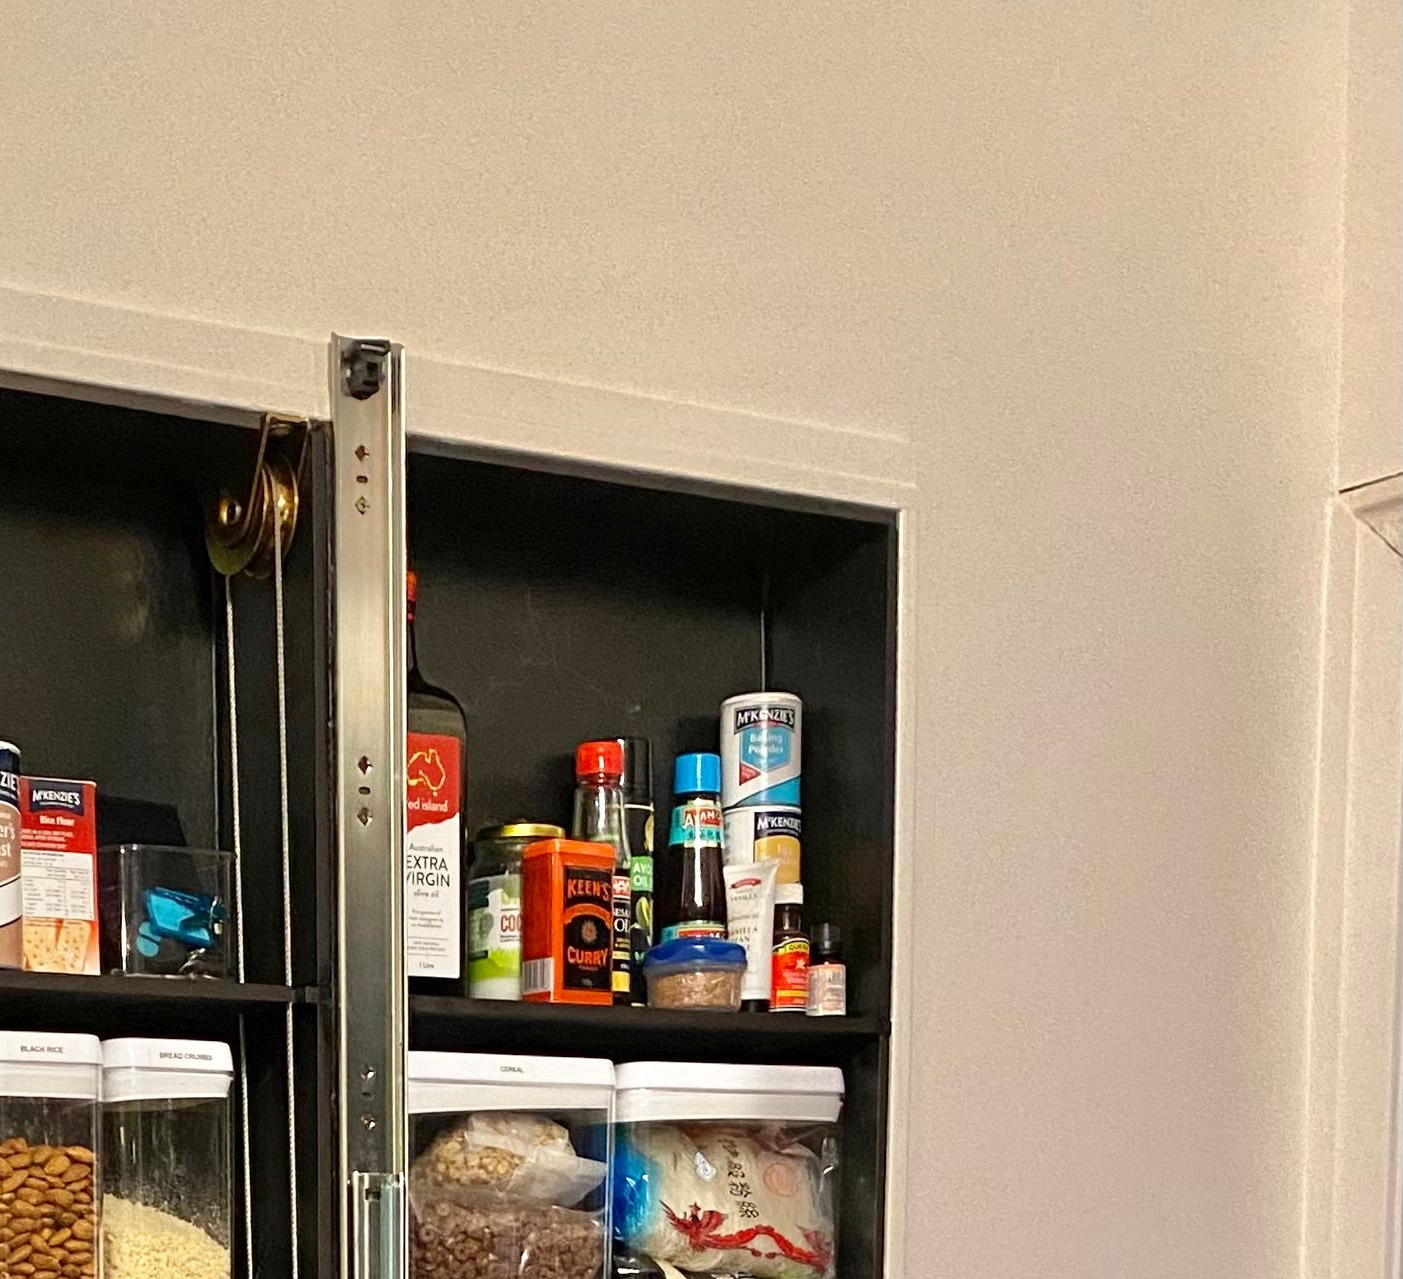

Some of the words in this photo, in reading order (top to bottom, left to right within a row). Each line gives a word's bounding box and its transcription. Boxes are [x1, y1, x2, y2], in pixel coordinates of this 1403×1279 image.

[421, 799, 449, 812] island
[406, 855, 448, 872] EXTRA
[567, 945, 609, 968] CURRY
[20, 1045, 45, 1053] BLACK
[47, 1046, 63, 1054] RICE
